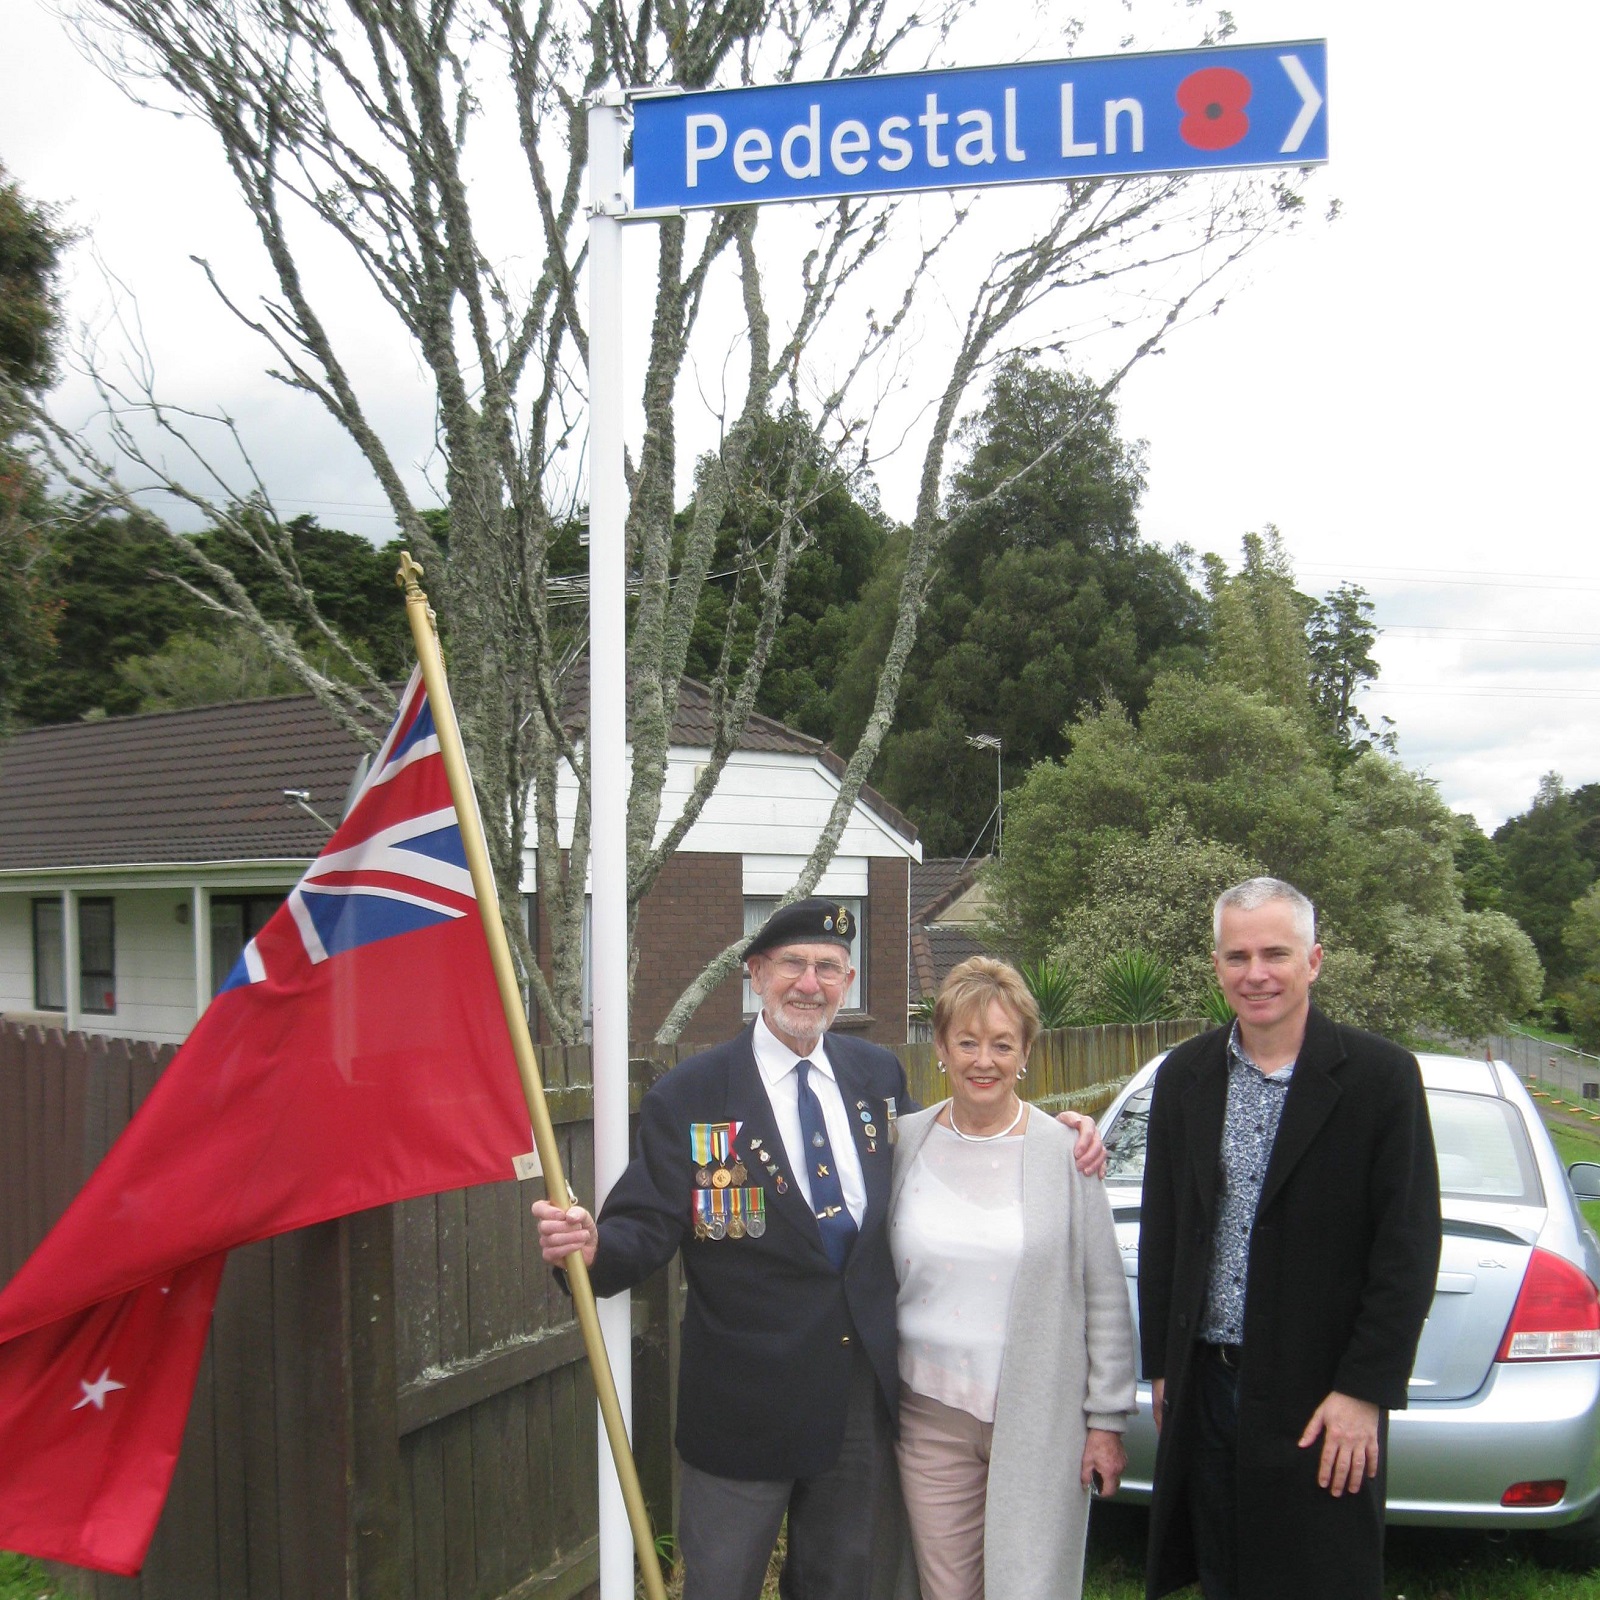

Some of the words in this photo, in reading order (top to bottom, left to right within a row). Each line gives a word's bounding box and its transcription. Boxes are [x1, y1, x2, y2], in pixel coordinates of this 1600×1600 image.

[686, 87, 1027, 188] Pedestal
[1061, 82, 1144, 158] Ln
[1478, 1258, 1507, 1269] EX
